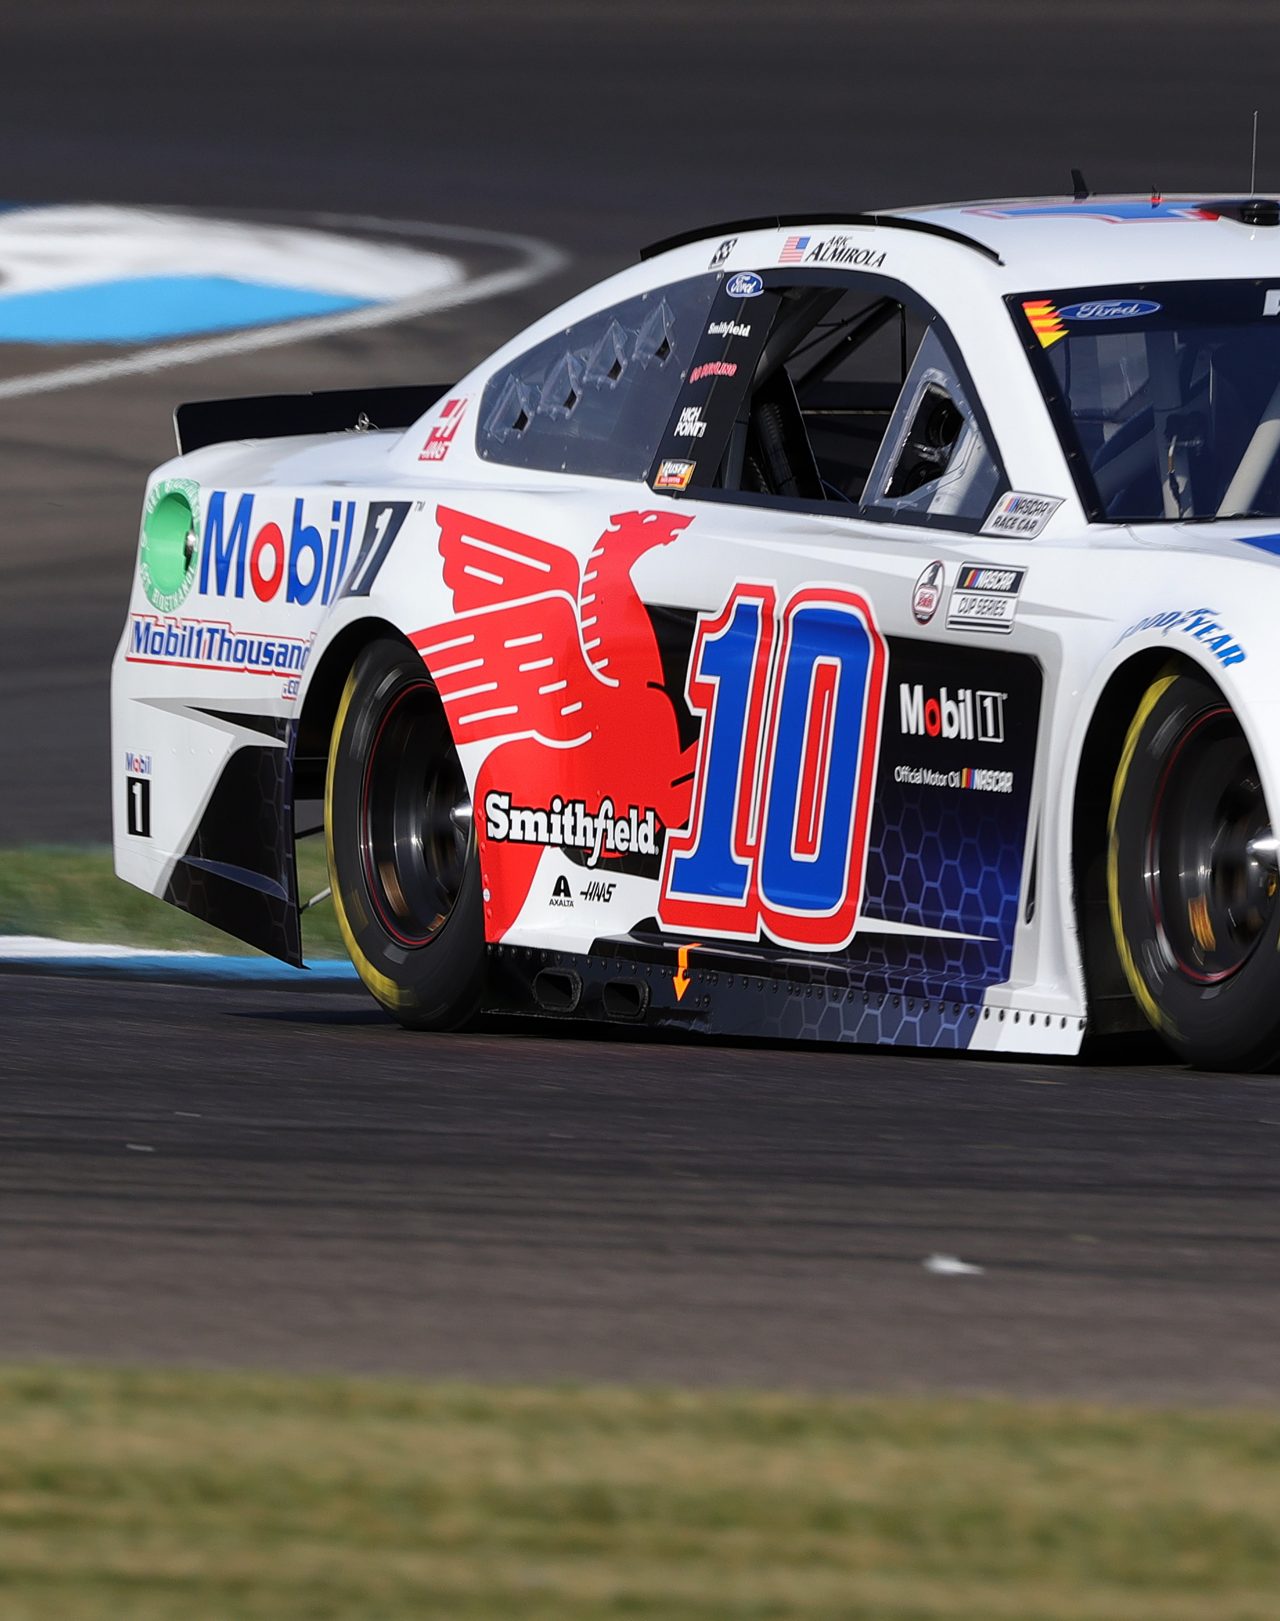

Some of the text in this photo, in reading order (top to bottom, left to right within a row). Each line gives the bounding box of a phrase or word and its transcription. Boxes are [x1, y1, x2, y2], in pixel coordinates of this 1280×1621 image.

[805, 243, 887, 268] ALMIROLA
[1075, 301, 1141, 318] Ford
[708, 320, 751, 338] Smithfield
[679, 406, 702, 422] HIGH
[1013, 497, 1050, 515] NASCAR
[992, 515, 1040, 533] RACE CAR
[199, 490, 356, 607] Mobil
[976, 569, 1017, 591] NASCAR
[958, 597, 1008, 616] CUP SERIES
[900, 683, 975, 741] Mobil
[125, 752, 151, 774] Mobil
[657, 576, 890, 952] 10
[894, 766, 1014, 793] Official Motor Oil NASCAR
[485, 792, 657, 868] Smithfield
[549, 898, 574, 908] AXALTA
